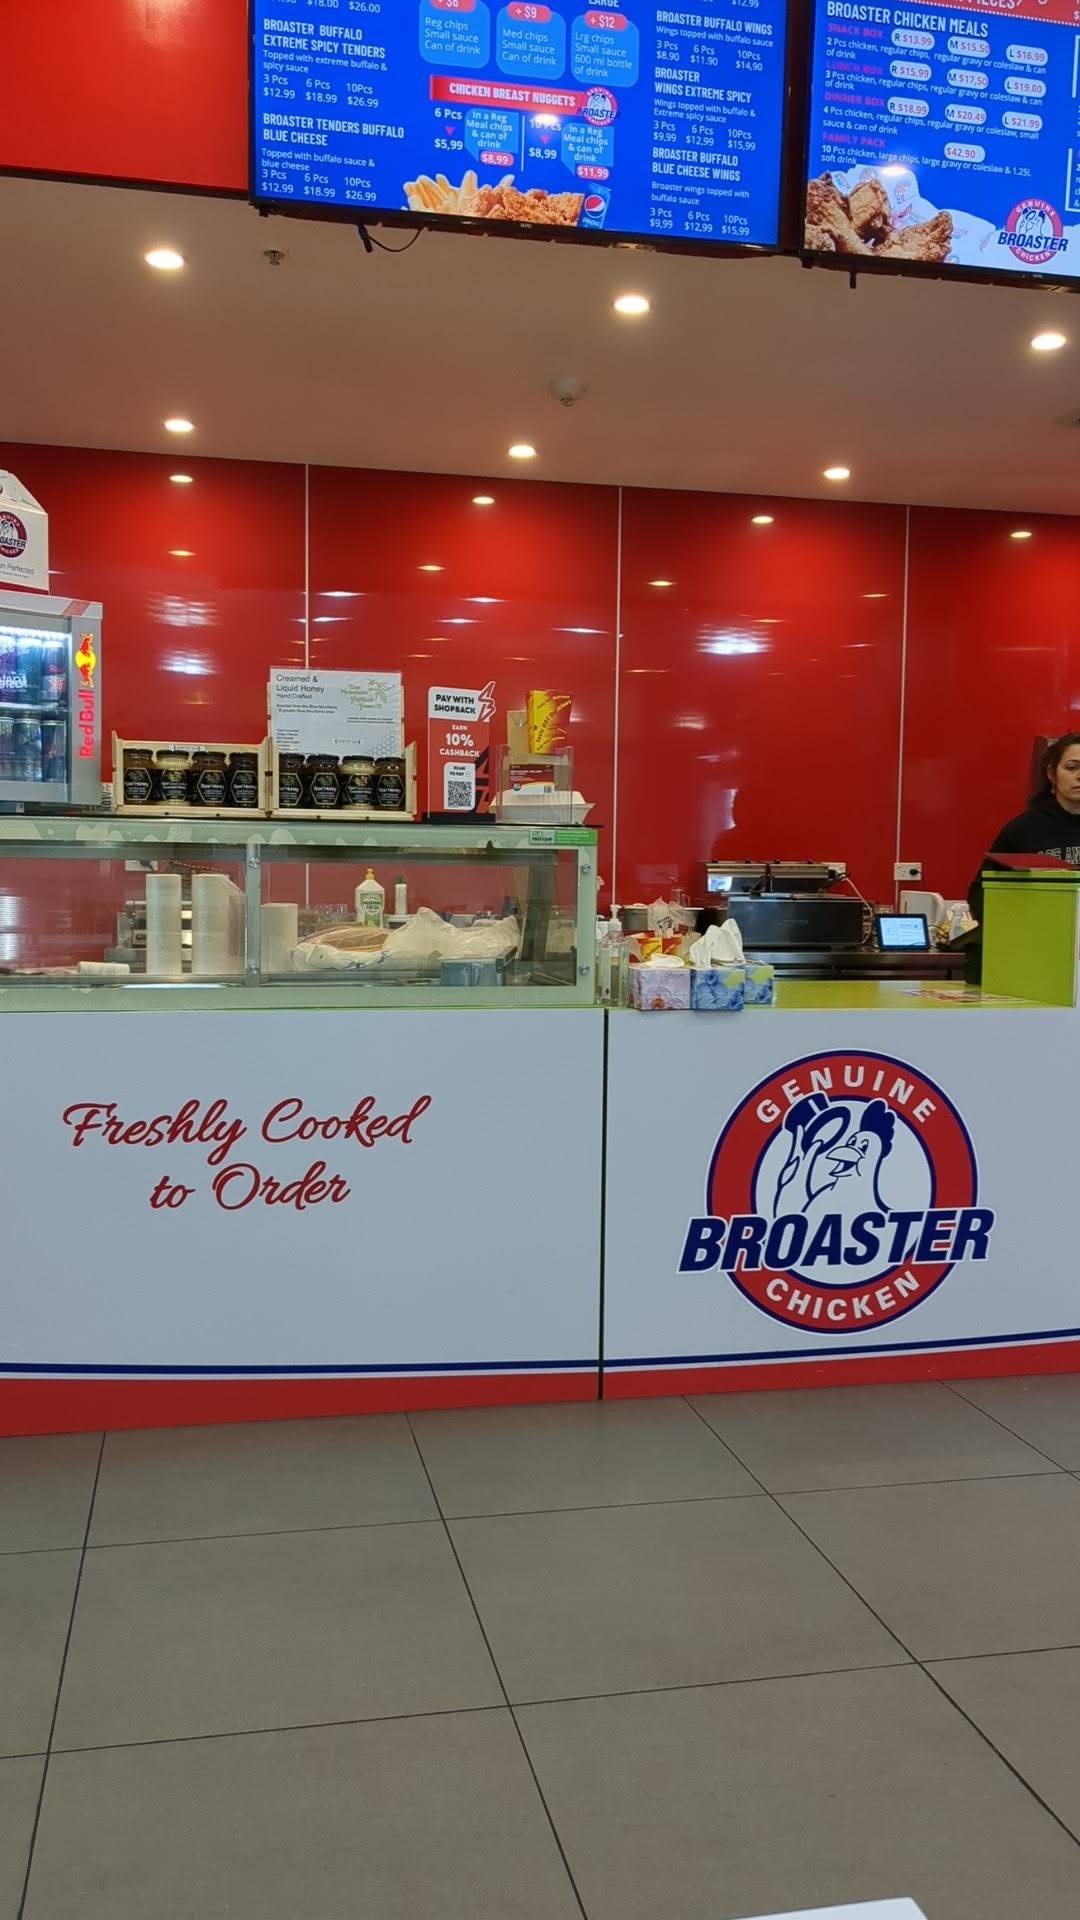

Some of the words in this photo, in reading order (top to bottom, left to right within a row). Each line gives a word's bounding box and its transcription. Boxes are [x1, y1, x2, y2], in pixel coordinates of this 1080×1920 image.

[349, 2, 380, 13] $26.00
[425, 17, 442, 29] Reg
[445, 20, 468, 31] chips
[657, 11, 702, 27] BROASTER
[704, 16, 742, 32] BUFFALO
[745, 21, 772, 36] WINGS
[827, 1, 890, 24] BROASTER
[894, 10, 945, 32] CHICKEN
[949, 18, 988, 38] MEALS
[264, 19, 314, 35] BROASTER
[320, 24, 362, 40] BUFFALO
[425, 28, 450, 40] Small
[452, 34, 479, 43] sauce
[503, 29, 522, 39] Med
[525, 32, 548, 43] chips
[656, 26, 678, 36] Wings
[680, 29, 706, 40] topped
[708, 32, 724, 40] with
[726, 34, 751, 45] buffalo
[828, 22, 860, 36] SNACK
[863, 27, 884, 38] BOX
[264, 35, 308, 50] EXTREME
[312, 40, 339, 54] SPICY
[342, 43, 386, 59] TENDERS
[425, 40, 441, 49] Can
[446, 42, 455, 51] of
[457, 43, 480, 55] drink
[502, 40, 526, 51] Small
[529, 45, 555, 54] sauce
[894, 33, 901, 41] R
[902, 35, 932, 46] $13.99
[949, 40, 958, 50] M
[960, 41, 990, 54] $15.50
[264, 50, 294, 63] Topped
[296, 54, 313, 63] with
[315, 56, 348, 67] extreme
[351, 59, 378, 70] buffalo
[503, 51, 519, 60] Can
[522, 53, 531, 63] of
[533, 55, 556, 66] drink
[1009, 49, 1014, 57] L
[1017, 49, 1045, 62] $16.99
[263, 62, 283, 73] spicy
[286, 64, 309, 73] sauce
[655, 67, 700, 82] BROASTER
[264, 74, 269, 83] 3
[272, 75, 288, 85] Pcs
[306, 79, 312, 88] 6
[315, 80, 330, 90] Pcs
[346, 83, 373, 94] 10Pcs
[450, 82, 490, 98] CHICKEN
[493, 86, 530, 102] BREAST
[532, 91, 575, 107] NUGGETS
[655, 82, 683, 96] WINGS
[685, 86, 724, 100] EXTREME
[726, 91, 751, 104] SPICY
[264, 87, 295, 99] $12.99
[305, 92, 337, 103] $18.99
[348, 96, 379, 108] $26.99
[825, 92, 862, 105] DINNER
[865, 96, 885, 107] BOX
[890, 102, 895, 110] R
[898, 103, 927, 115] $18.99
[263, 113, 313, 129] BROASTER
[317, 118, 359, 134] TENDERS
[362, 122, 404, 138] BUFFALO
[263, 129, 288, 142] BLUE
[291, 132, 328, 146] CHEESE
[822, 132, 860, 145] FAMILY
[863, 136, 885, 148] PACK
[653, 148, 698, 162] BROASTER
[700, 152, 738, 166] BUFFALO
[833, 146, 845, 154] Pcs
[847, 148, 876, 159] chicken,
[879, 152, 897, 162] large
[899, 155, 920, 164] chips,
[922, 157, 940, 167] large
[942, 160, 961, 170] gravy
[973, 163, 1003, 174] coleslaw
[1005, 166, 1010, 174] &
[838, 156, 856, 164] drink
[653, 162, 675, 174] BLUE
[677, 166, 710, 179] CHEESE
[713, 169, 740, 181] WINGS
[262, 182, 293, 193] $12.99
[304, 186, 335, 197] $18.99
[345, 190, 376, 202] $26.99
[1016, 200, 1056, 216] GENUINE
[998, 232, 1068, 251] BROASTER
[1016, 249, 1051, 261] CHICKEN
[276, 684, 298, 692] Liquid
[300, 685, 324, 693] Honey
[78, 689, 94, 722] Bull
[436, 694, 452, 702] PAY
[453, 696, 474, 704] WITH
[434, 704, 476, 714] SHOPBACK
[79, 724, 94, 758] Red
[446, 733, 474, 747] 10%
[440, 748, 480, 758] CASHBACK
[756, 1065, 936, 1124] GENUINE
[62, 1099, 247, 1166] Freshly
[262, 1095, 432, 1147] Cooked
[149, 1176, 195, 1208] to
[212, 1161, 351, 1210] Order
[677, 1208, 995, 1272] BROASTER
[766, 1271, 920, 1321] CHICKEN
